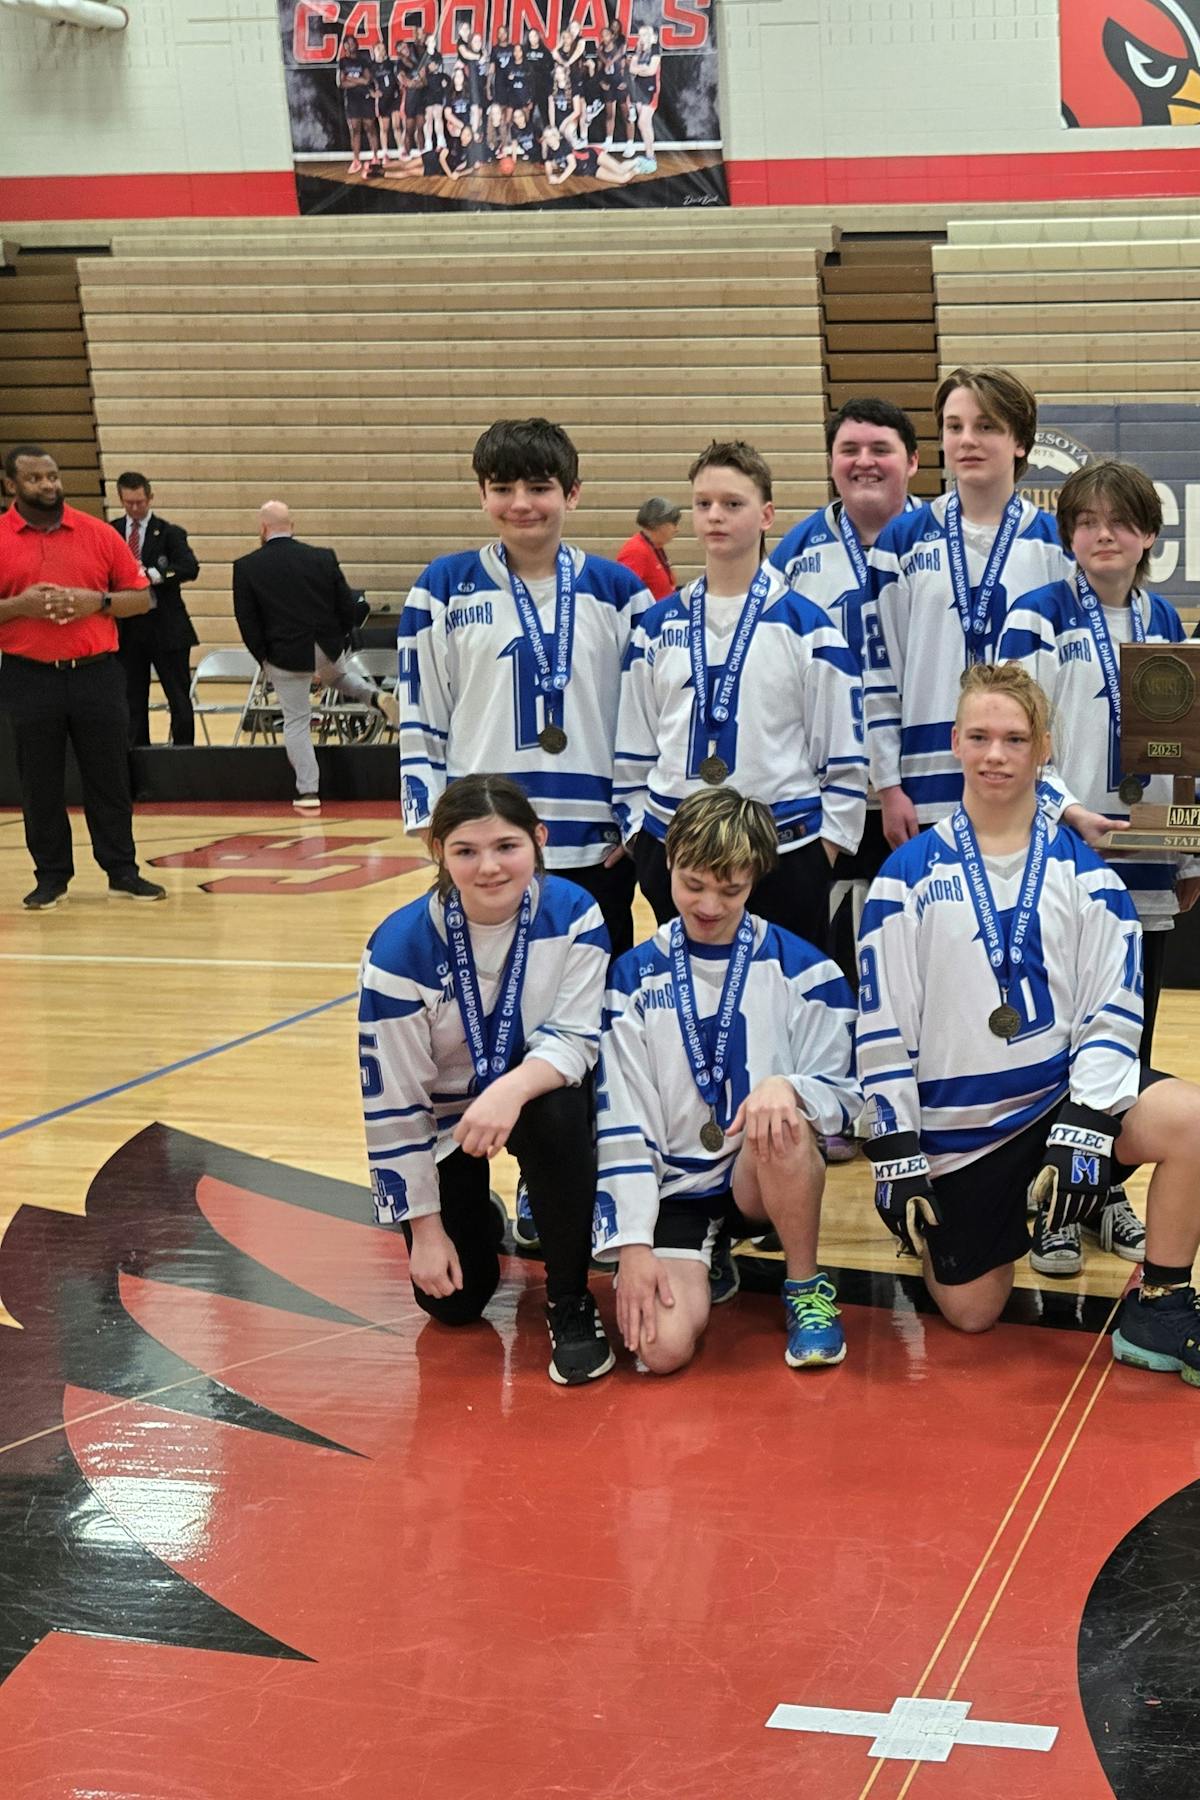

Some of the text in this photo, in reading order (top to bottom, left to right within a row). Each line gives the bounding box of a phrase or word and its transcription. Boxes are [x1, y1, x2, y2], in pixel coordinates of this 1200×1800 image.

[1034, 432, 1089, 466] ESOTA
[951, 541, 969, 614] CHAMPIONSHIPS
[977, 518, 1015, 618] STATE CHAMPIONSHIPS
[519, 598, 550, 674] CHAMPIONSHIPS
[557, 567, 571, 673] STATE CHAMPIONSHIPS
[692, 598, 705, 706] STATE CHAMPIONSHIPS
[719, 598, 761, 706] STATE CHAMPIONSHIPS
[1089, 611, 1106, 641] STATE
[1151, 744, 1178, 756] 2025
[959, 830, 1000, 949] STATE CHAMPIONSHIPS
[1014, 830, 1046, 945] STATE CHAMPIONSHIPS
[453, 932, 468, 966] STATE
[495, 927, 527, 1054] STATE CHAMPIONSHIPS
[459, 969, 484, 1058] CHAMPIONSHIPS
[675, 950, 706, 1069] STATE CHAMPIONSHIPS
[715, 944, 748, 1065] STATE CHAMPIONSHIPS
[875, 1154, 928, 1179] MYLEC
[1049, 1126, 1107, 1150] MYLEC
